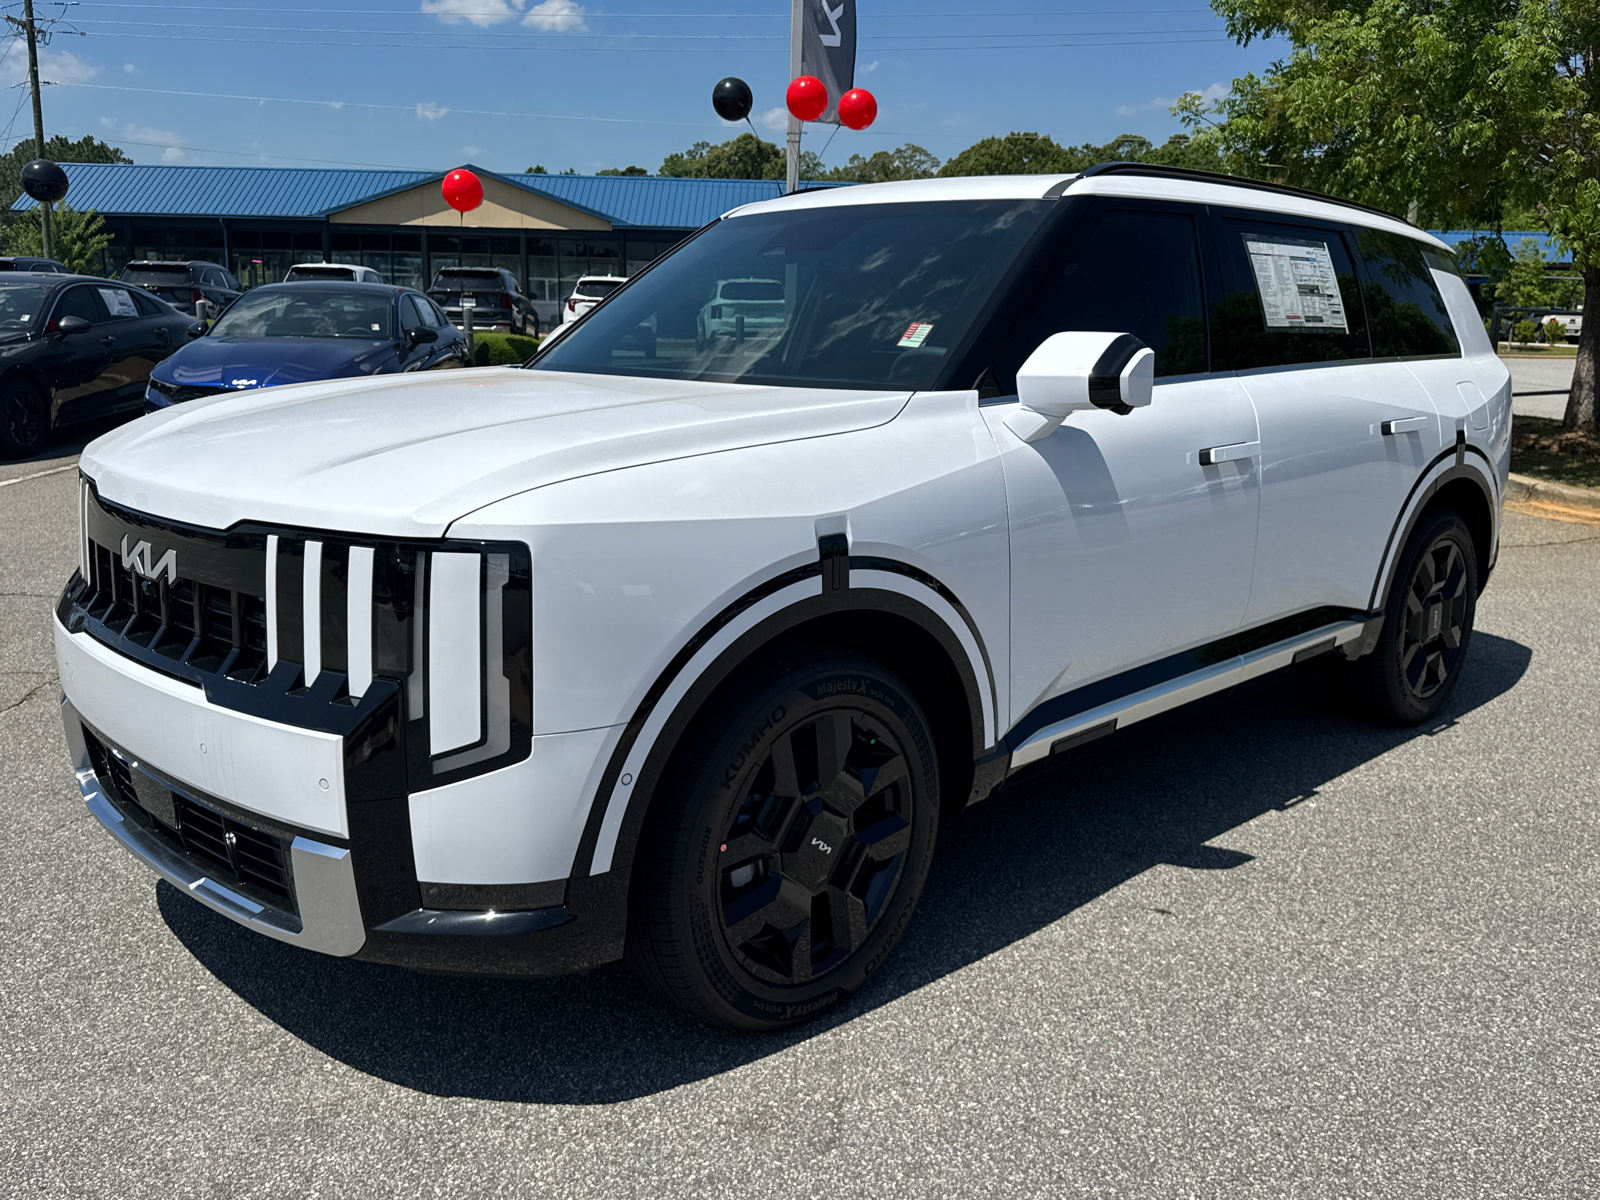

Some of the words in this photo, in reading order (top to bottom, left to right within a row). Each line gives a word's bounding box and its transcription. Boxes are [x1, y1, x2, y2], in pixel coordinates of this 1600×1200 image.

[121, 533, 177, 587] KIA
[719, 704, 787, 790] KUMHO
[696, 825, 712, 885] OUTSIDE
[811, 837, 833, 855] KIA
[864, 897, 915, 975] KUMHO
